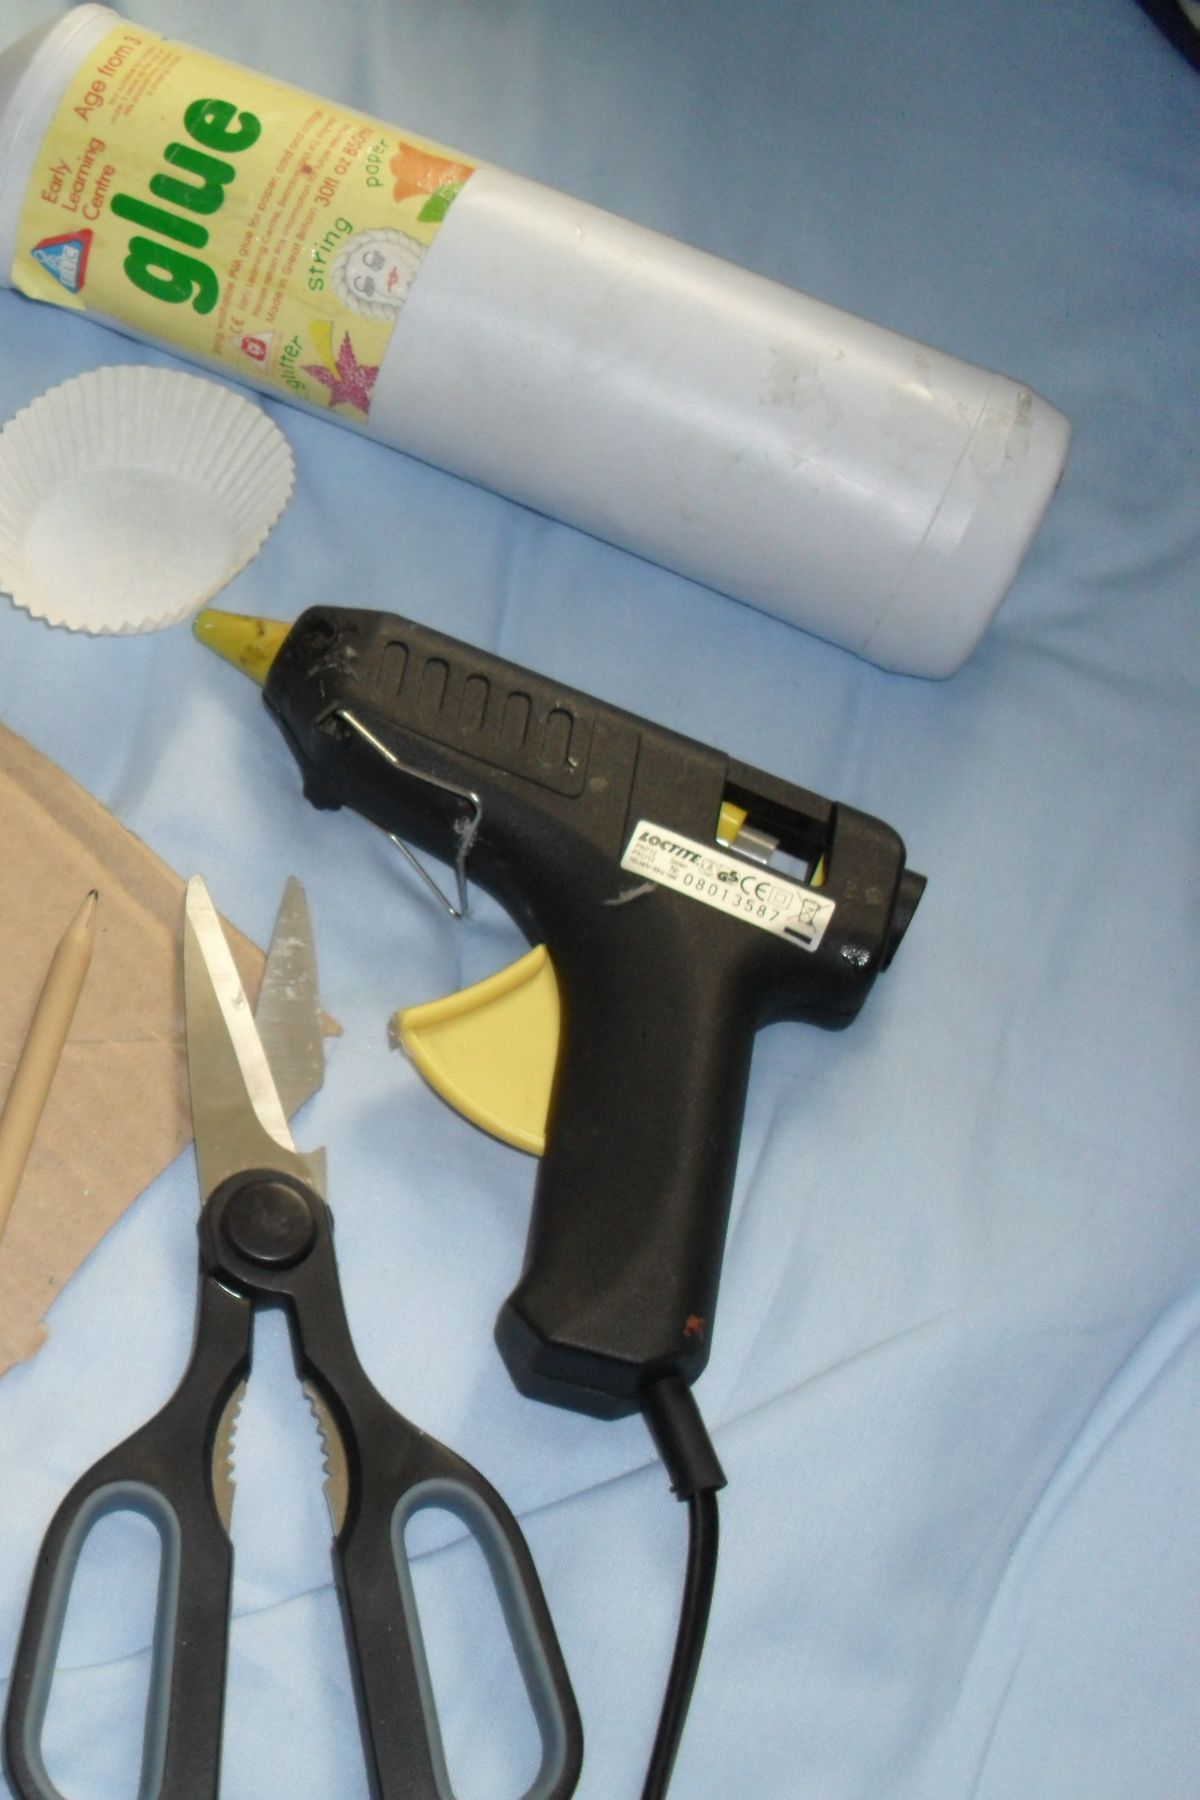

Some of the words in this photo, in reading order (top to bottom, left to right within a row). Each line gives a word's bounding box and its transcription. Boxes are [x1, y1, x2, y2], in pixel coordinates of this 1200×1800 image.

[73, 77, 106, 120] Age
[96, 44, 134, 77] from
[40, 158, 71, 203] Early
[60, 136, 106, 210] Learning
[333, 156, 352, 176] oz
[366, 139, 388, 188] paper
[82, 164, 114, 220] Centre
[110, 98, 262, 315] glue
[238, 230, 253, 255] glue
[281, 242, 301, 275] Great
[308, 217, 354, 291] string
[280, 335, 305, 388] glitter
[638, 832, 702, 864] LOCTITE
[683, 873, 781, 922] 08013587
